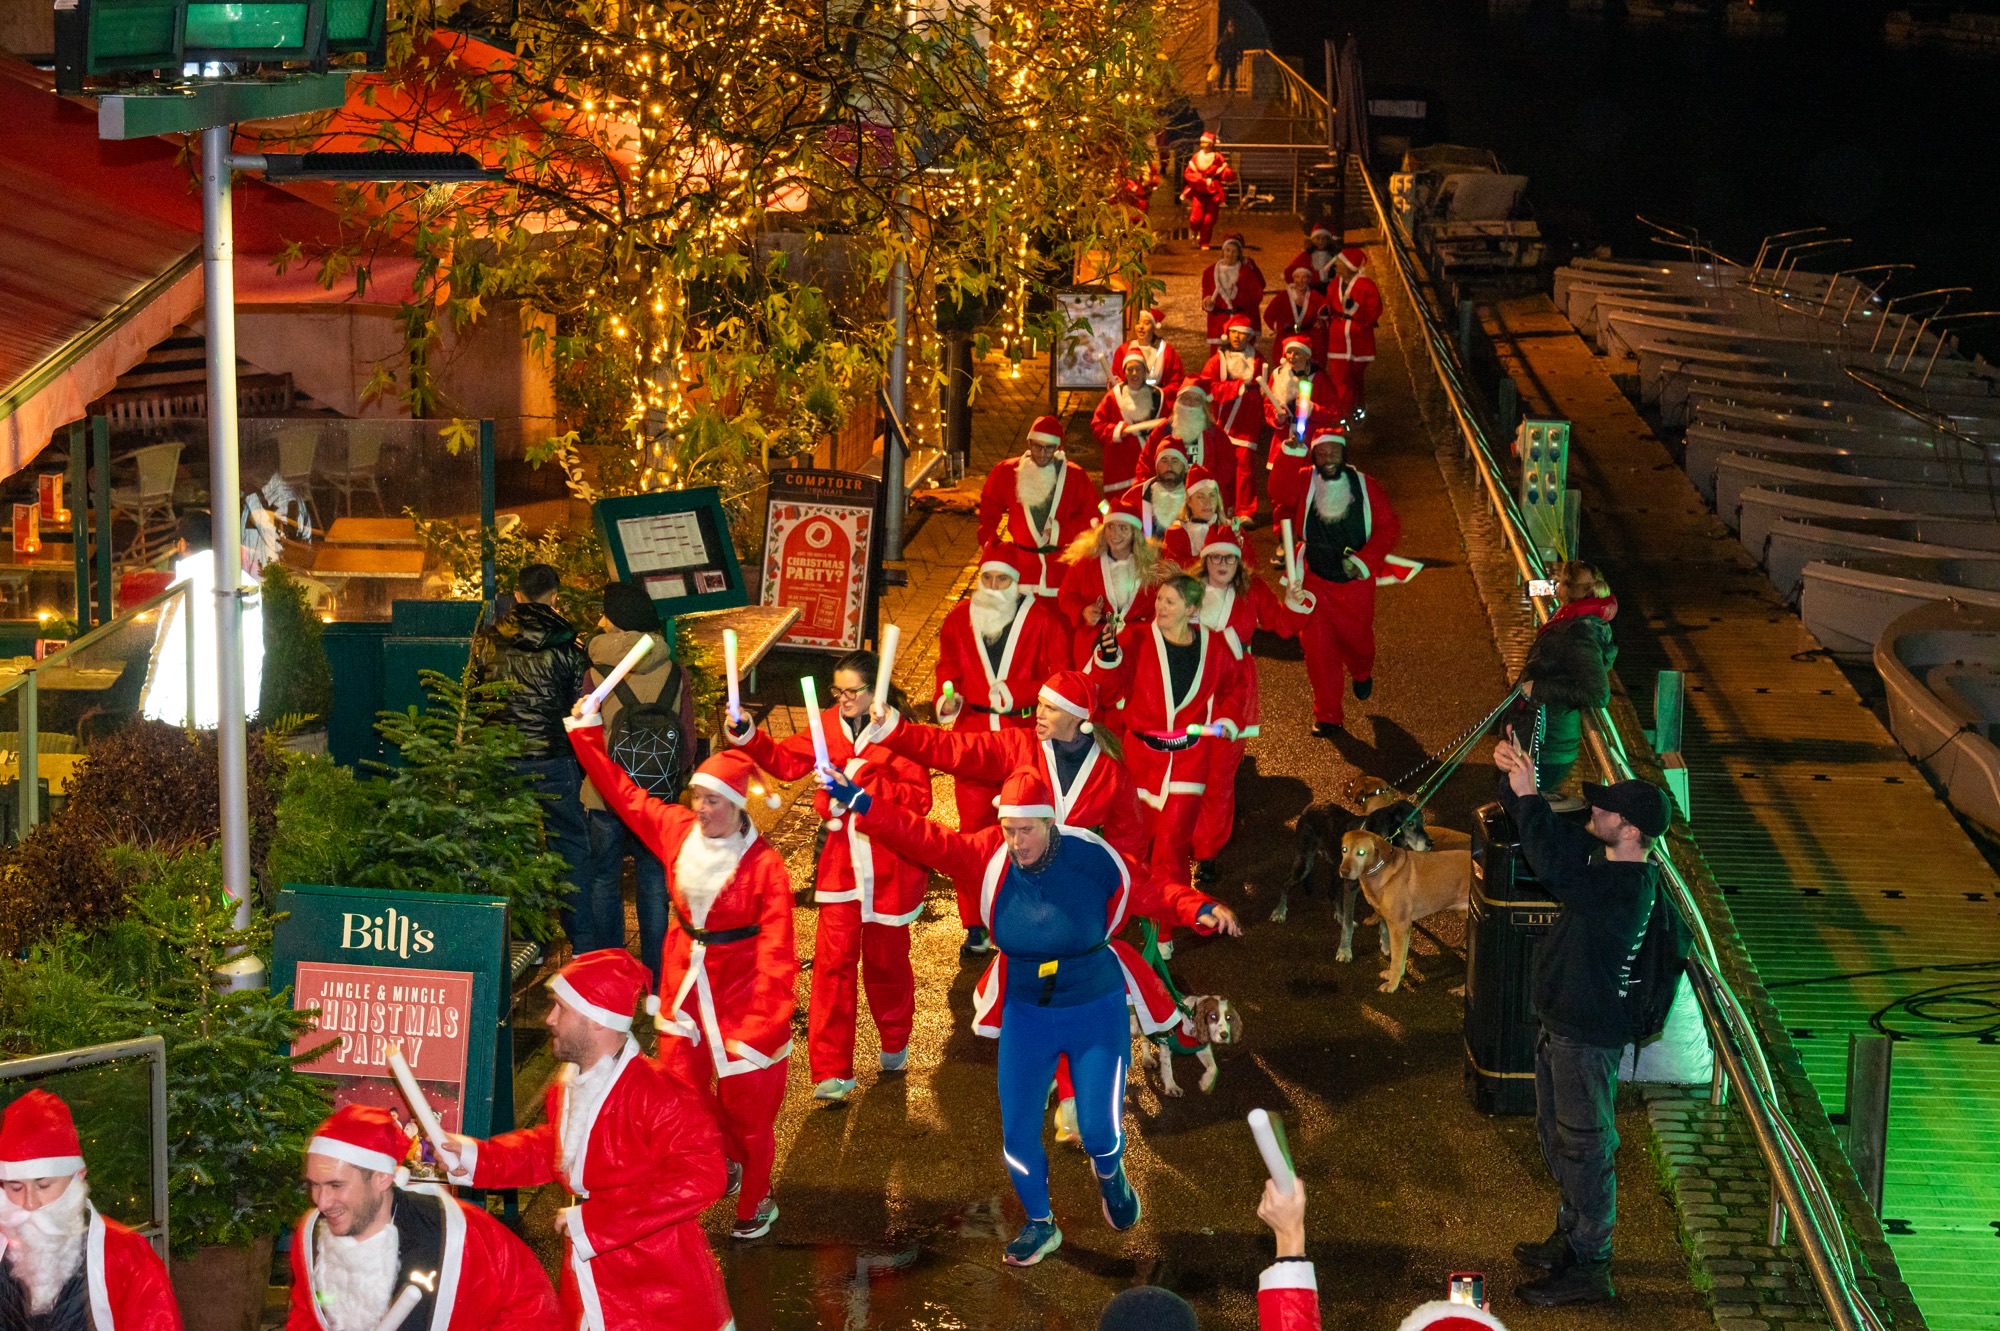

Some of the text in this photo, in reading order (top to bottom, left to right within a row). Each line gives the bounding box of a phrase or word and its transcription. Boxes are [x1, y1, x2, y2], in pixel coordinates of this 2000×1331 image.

[785, 474, 862, 490] COMPTOIR
[787, 556, 845, 569] CHRISTMAS
[786, 566, 844, 583] PARTY?
[340, 907, 435, 959] Bill's
[320, 981, 446, 1004] JINGLE & MINGLE
